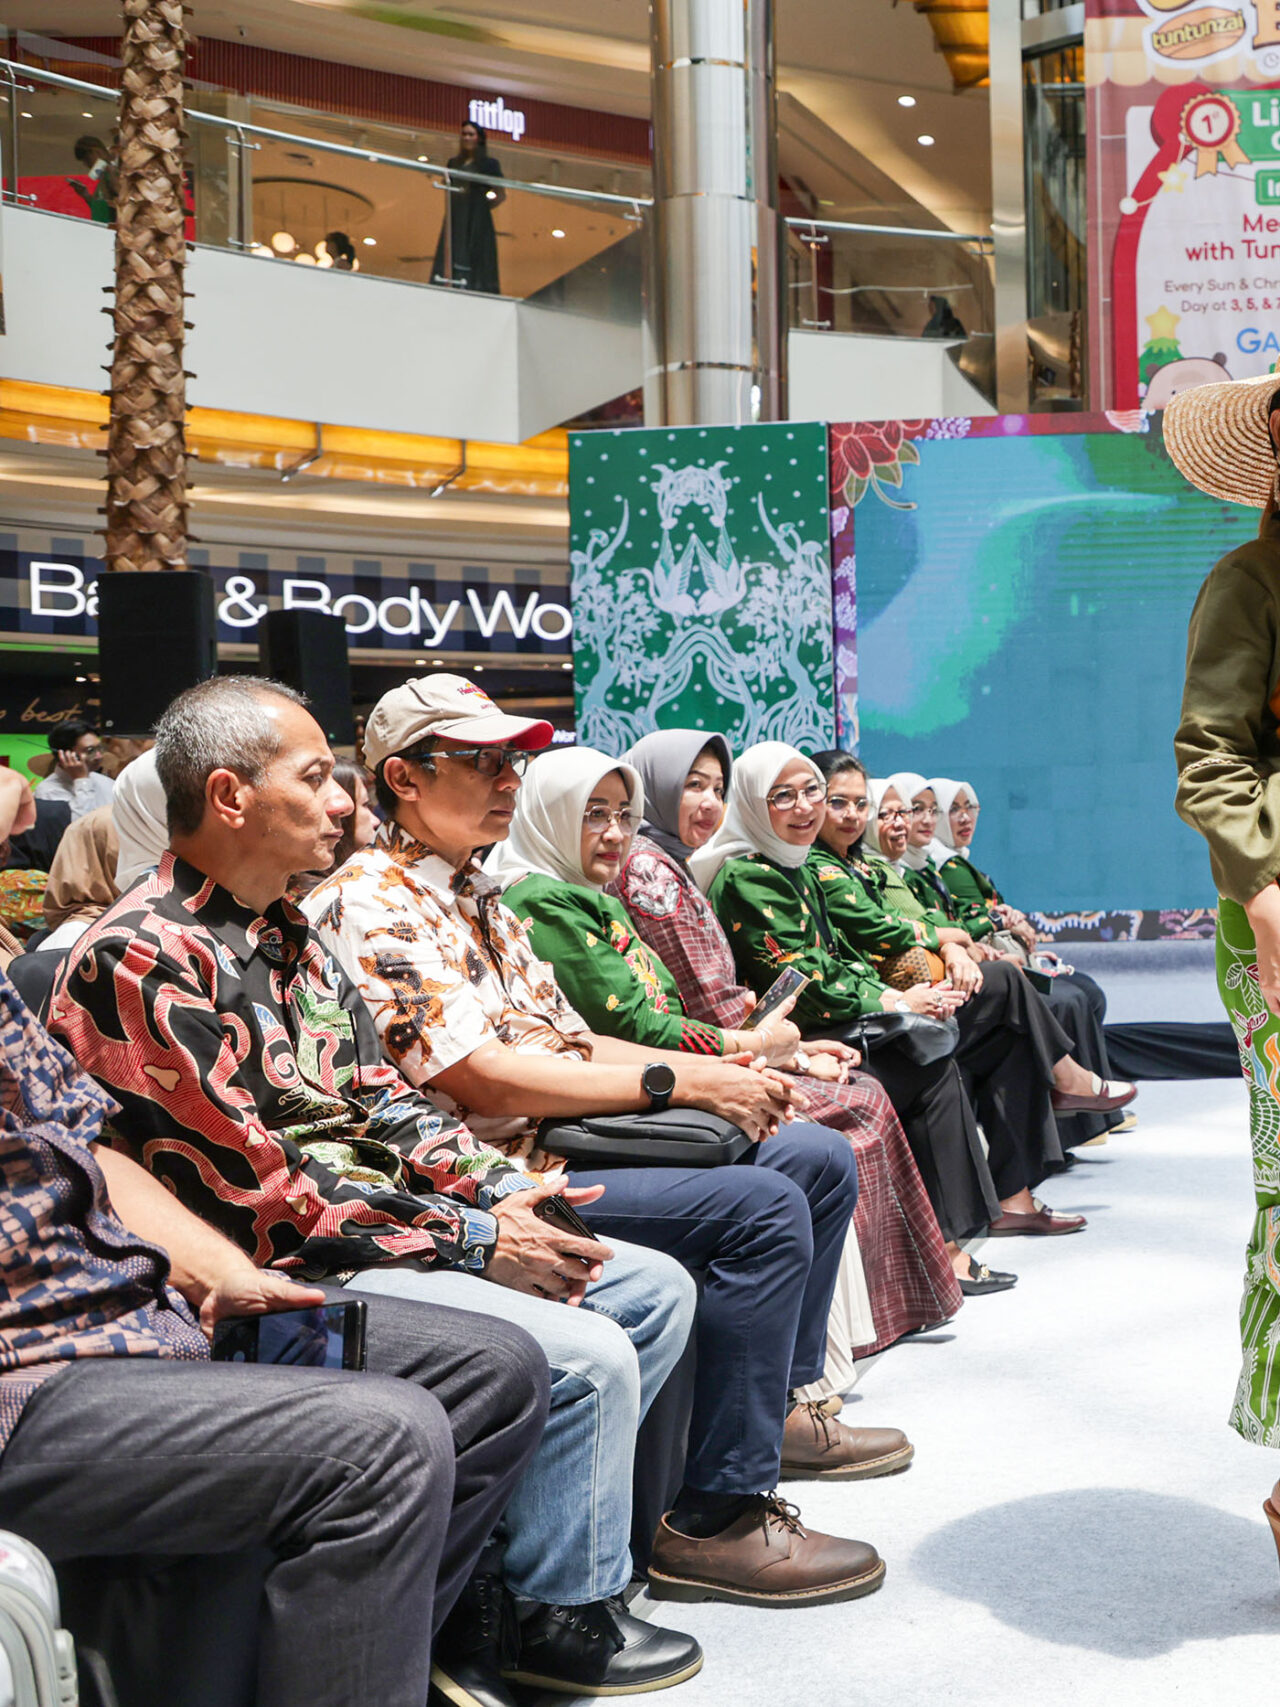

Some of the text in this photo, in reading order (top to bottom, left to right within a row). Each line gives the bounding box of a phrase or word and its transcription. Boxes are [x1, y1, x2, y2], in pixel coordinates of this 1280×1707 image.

[1152, 9, 1246, 49] tuntunzai
[1185, 241, 1235, 262] with
[1164, 280, 1203, 294] Every
[1207, 279, 1235, 292] Sun
[1239, 278, 1249, 291] &
[1181, 300, 1209, 314] Day
[1212, 299, 1227, 312] at
[1231, 298, 1243, 312] 3,
[1246, 297, 1258, 311] 5,
[1262, 297, 1272, 310] &
[217, 576, 268, 627] &
[282, 578, 461, 647] Body
